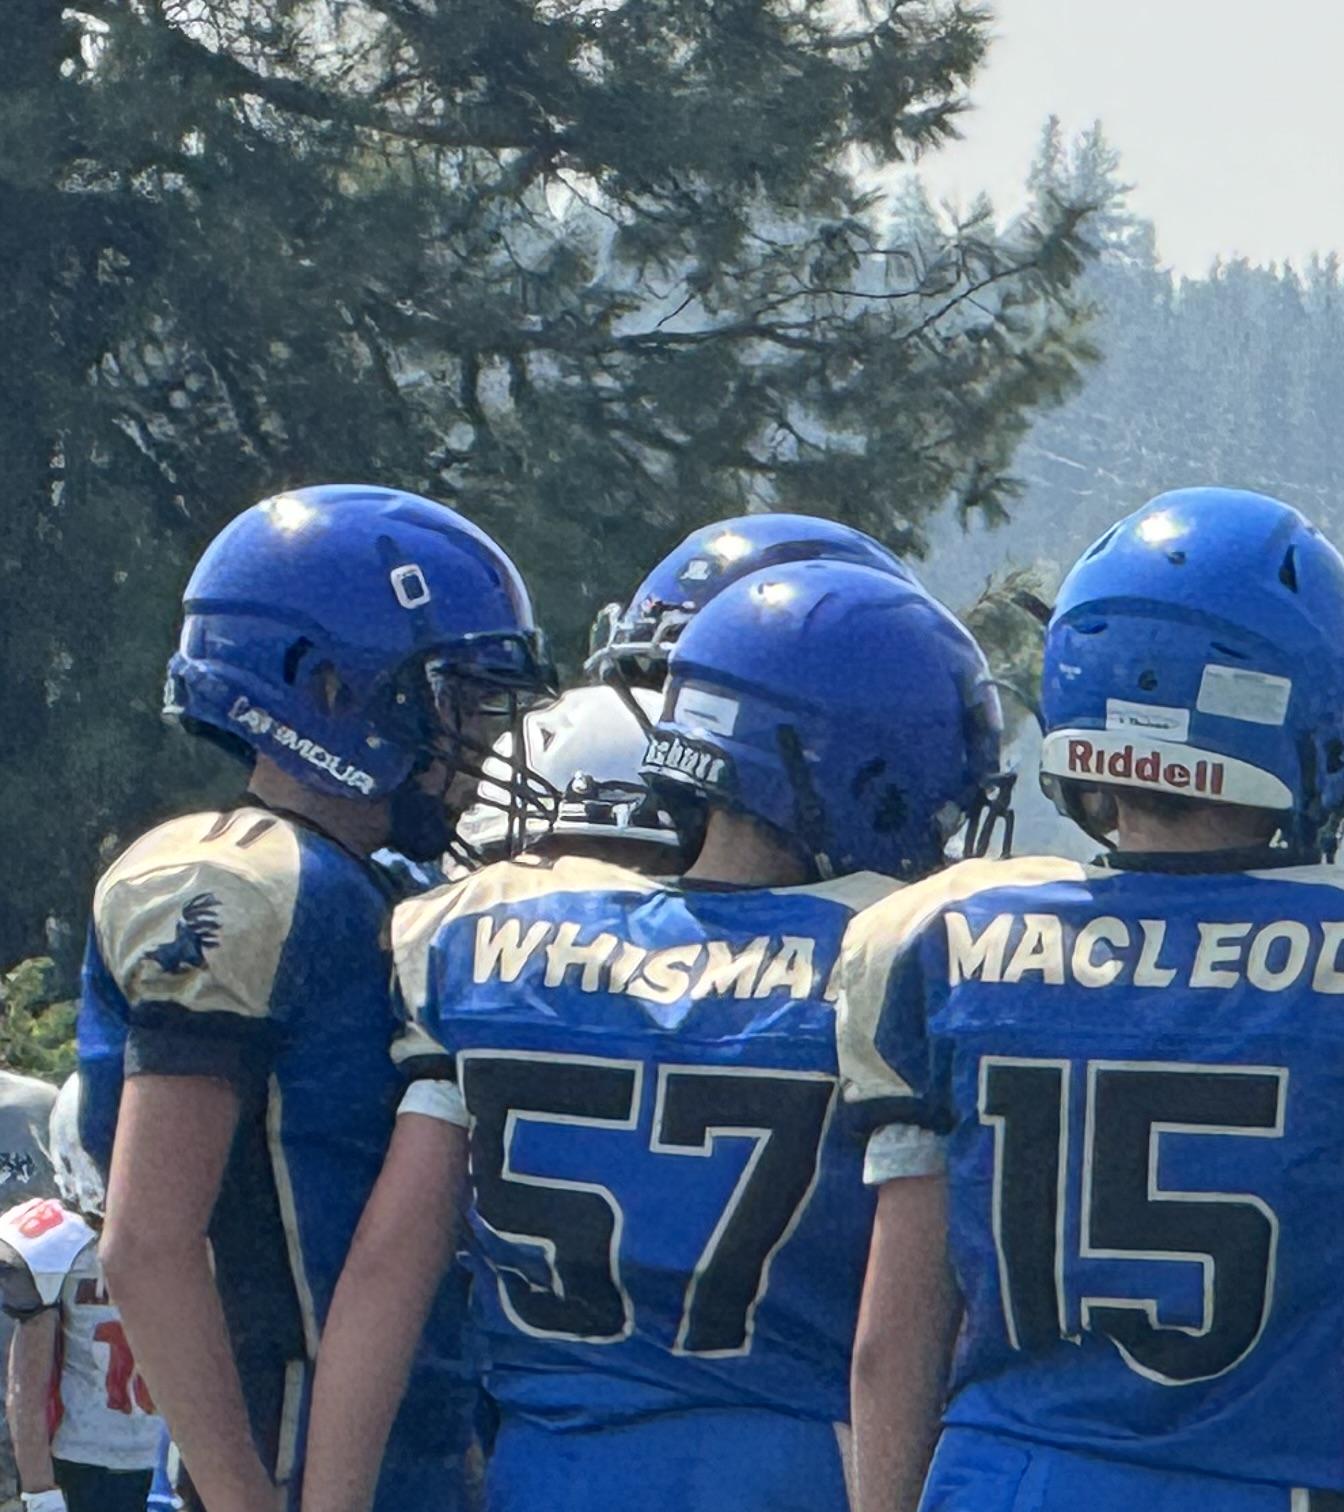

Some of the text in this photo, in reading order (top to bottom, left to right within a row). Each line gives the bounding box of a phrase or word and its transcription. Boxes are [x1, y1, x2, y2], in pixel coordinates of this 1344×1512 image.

[1067, 739, 1225, 796] Riddell
[472, 914, 840, 1005] WHISMA
[456, 1049, 839, 1359] 57
[978, 1055, 1290, 1387] 15
